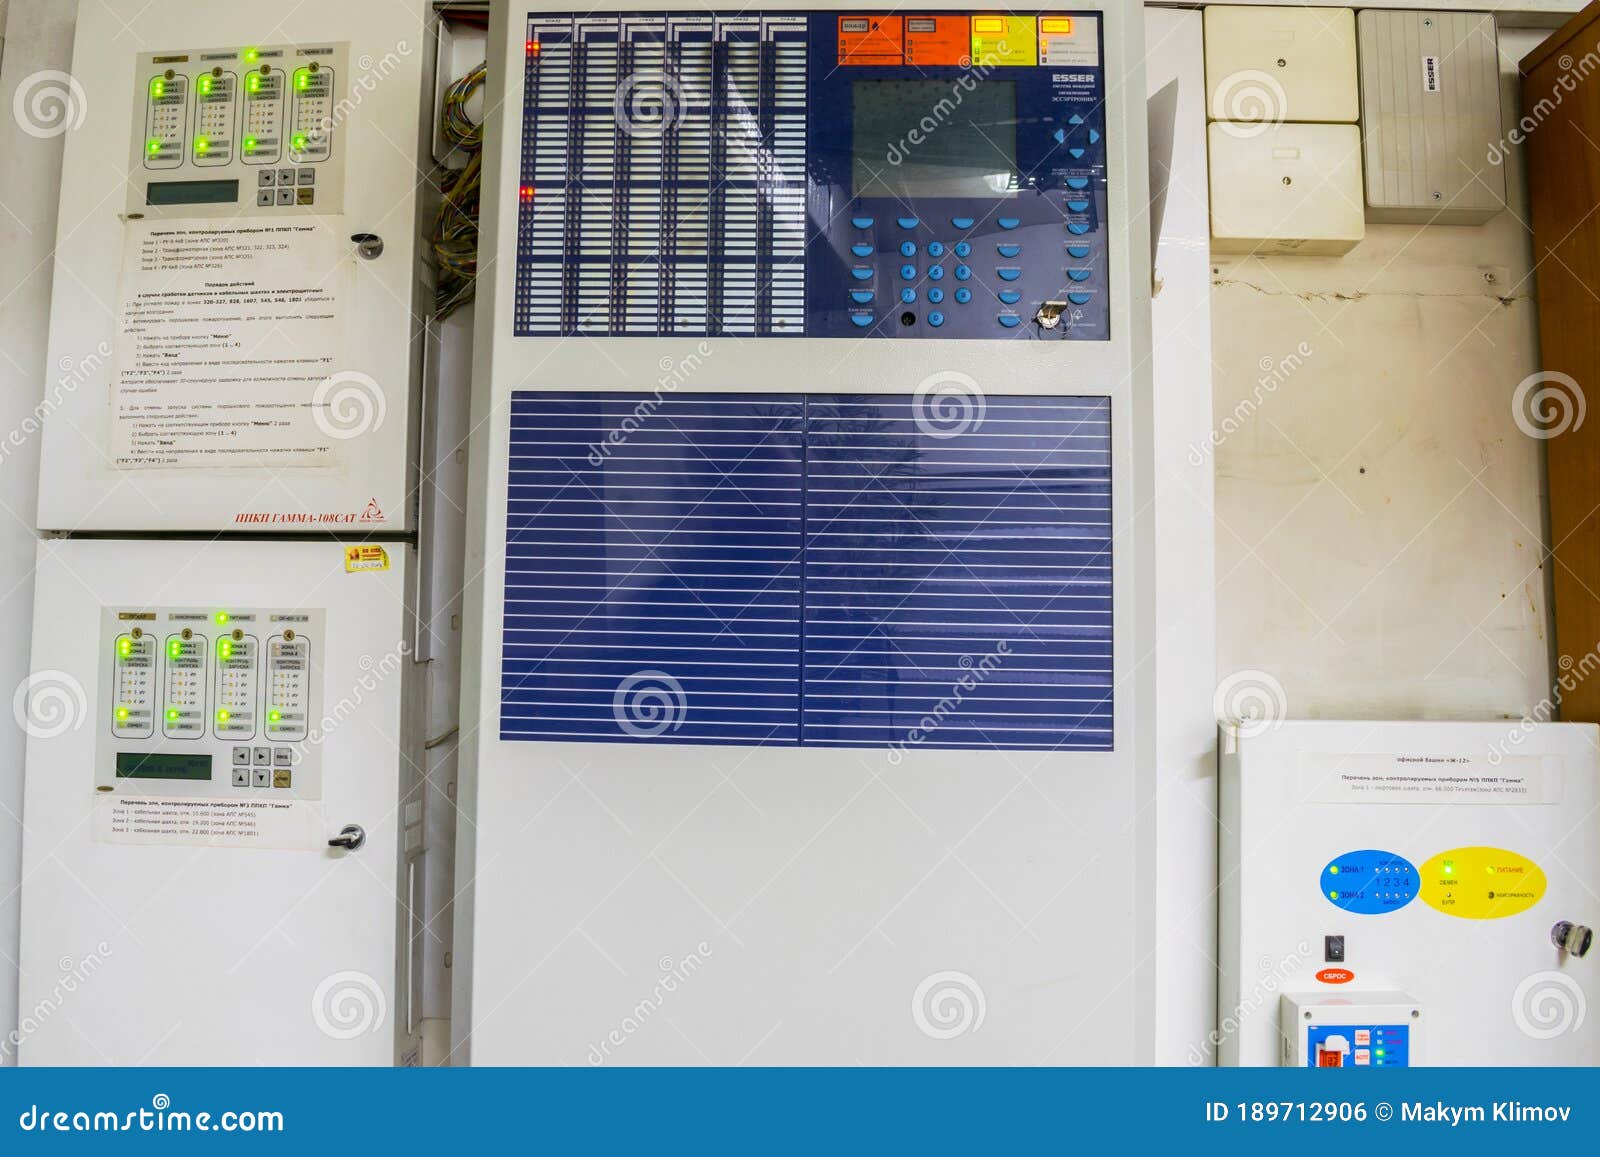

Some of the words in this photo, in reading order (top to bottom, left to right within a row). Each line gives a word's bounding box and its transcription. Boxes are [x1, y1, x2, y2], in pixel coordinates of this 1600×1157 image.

[1052, 74, 1095, 82] ESSER
[1427, 58, 1435, 90] ESSER
[235, 514, 270, 523] ППКП
[1384, 878, 1390, 886] 2
